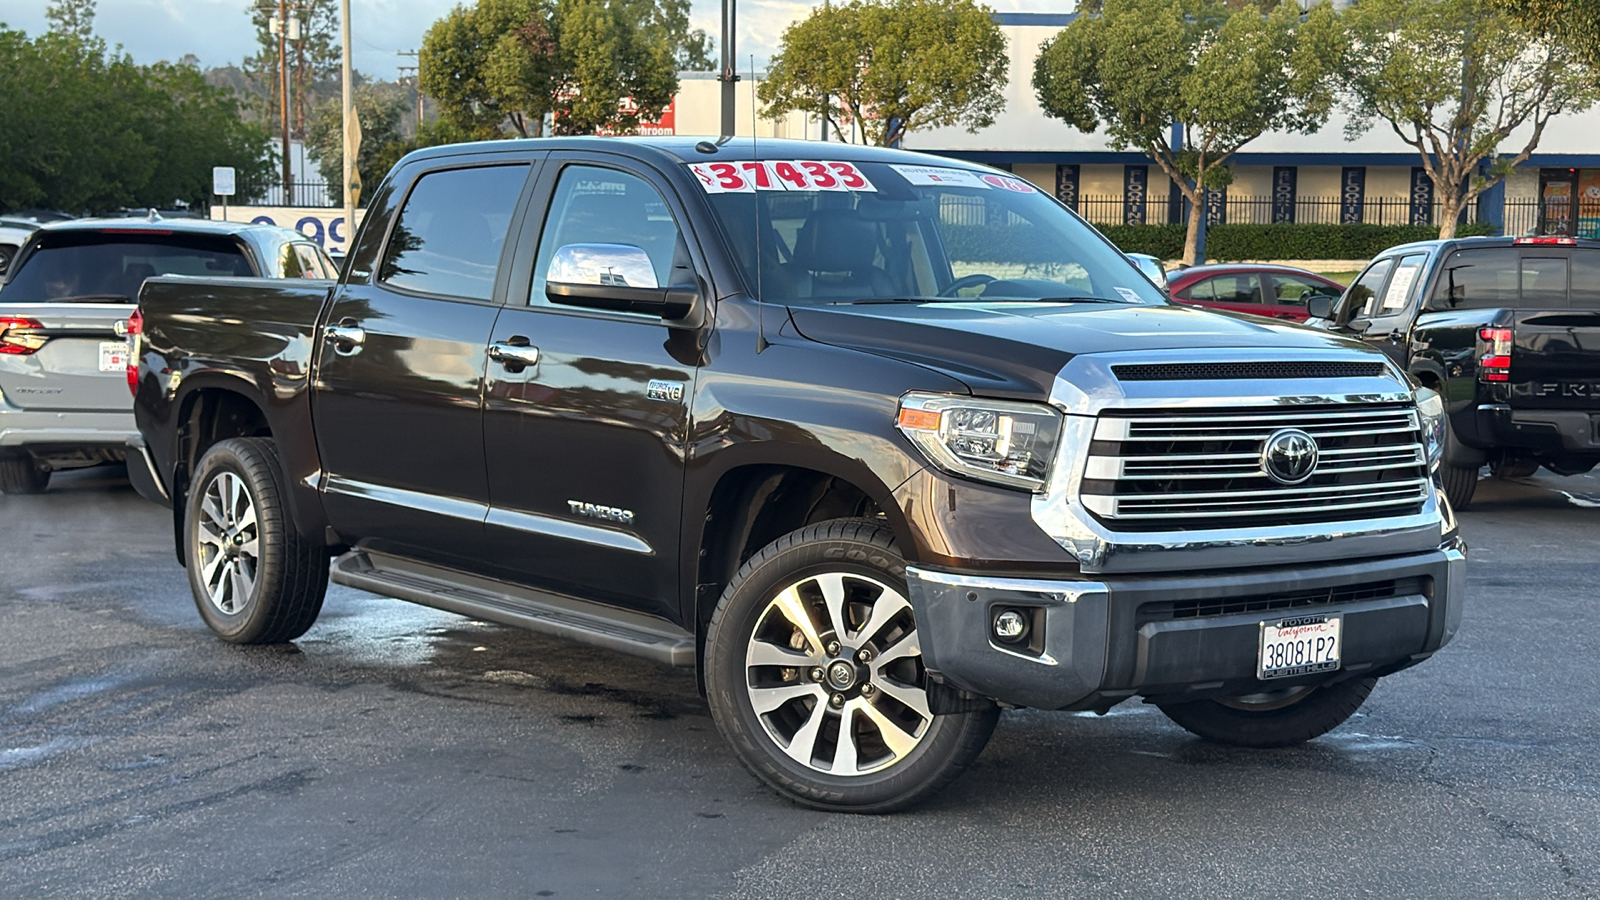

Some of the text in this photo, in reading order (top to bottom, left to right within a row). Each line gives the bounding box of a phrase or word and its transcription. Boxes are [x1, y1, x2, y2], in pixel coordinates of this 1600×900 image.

[694, 162, 868, 190] $37433
[567, 500, 635, 524] TUNDRA
[1277, 624, 1327, 639] California
[1265, 636, 1336, 669] 38081P2
